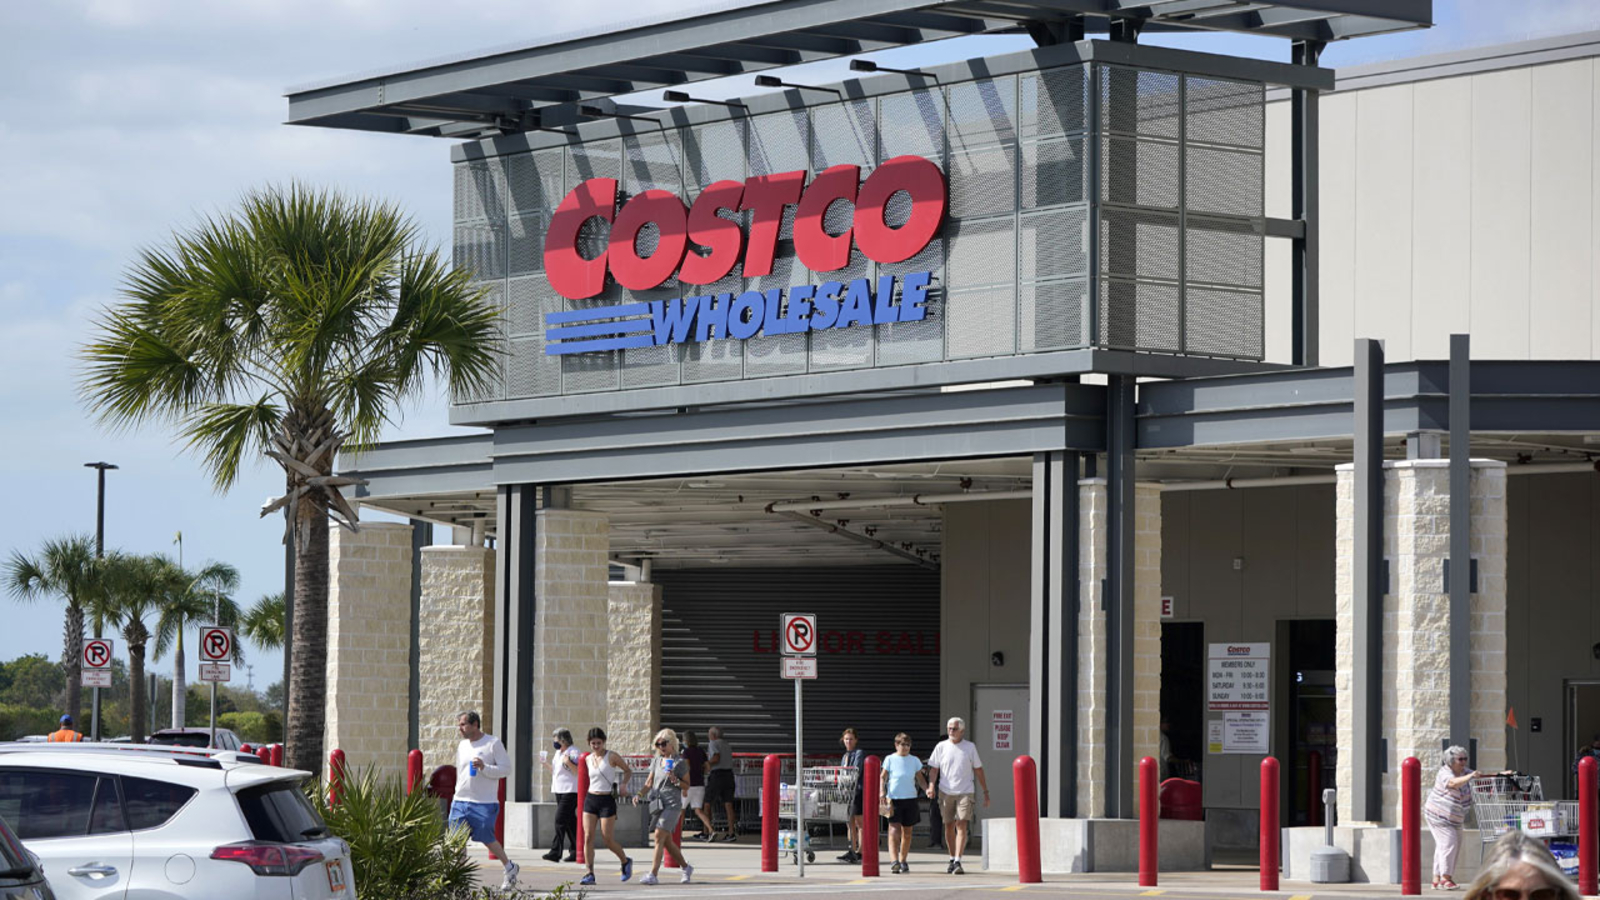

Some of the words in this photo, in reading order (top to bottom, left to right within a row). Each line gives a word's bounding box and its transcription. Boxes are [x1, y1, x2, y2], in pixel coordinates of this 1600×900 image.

[544, 154, 948, 300] COSTCO
[649, 271, 932, 346] WHOLESALE
[994, 724, 1011, 732] PLEASE
[995, 741, 1010, 749] CLEAR
